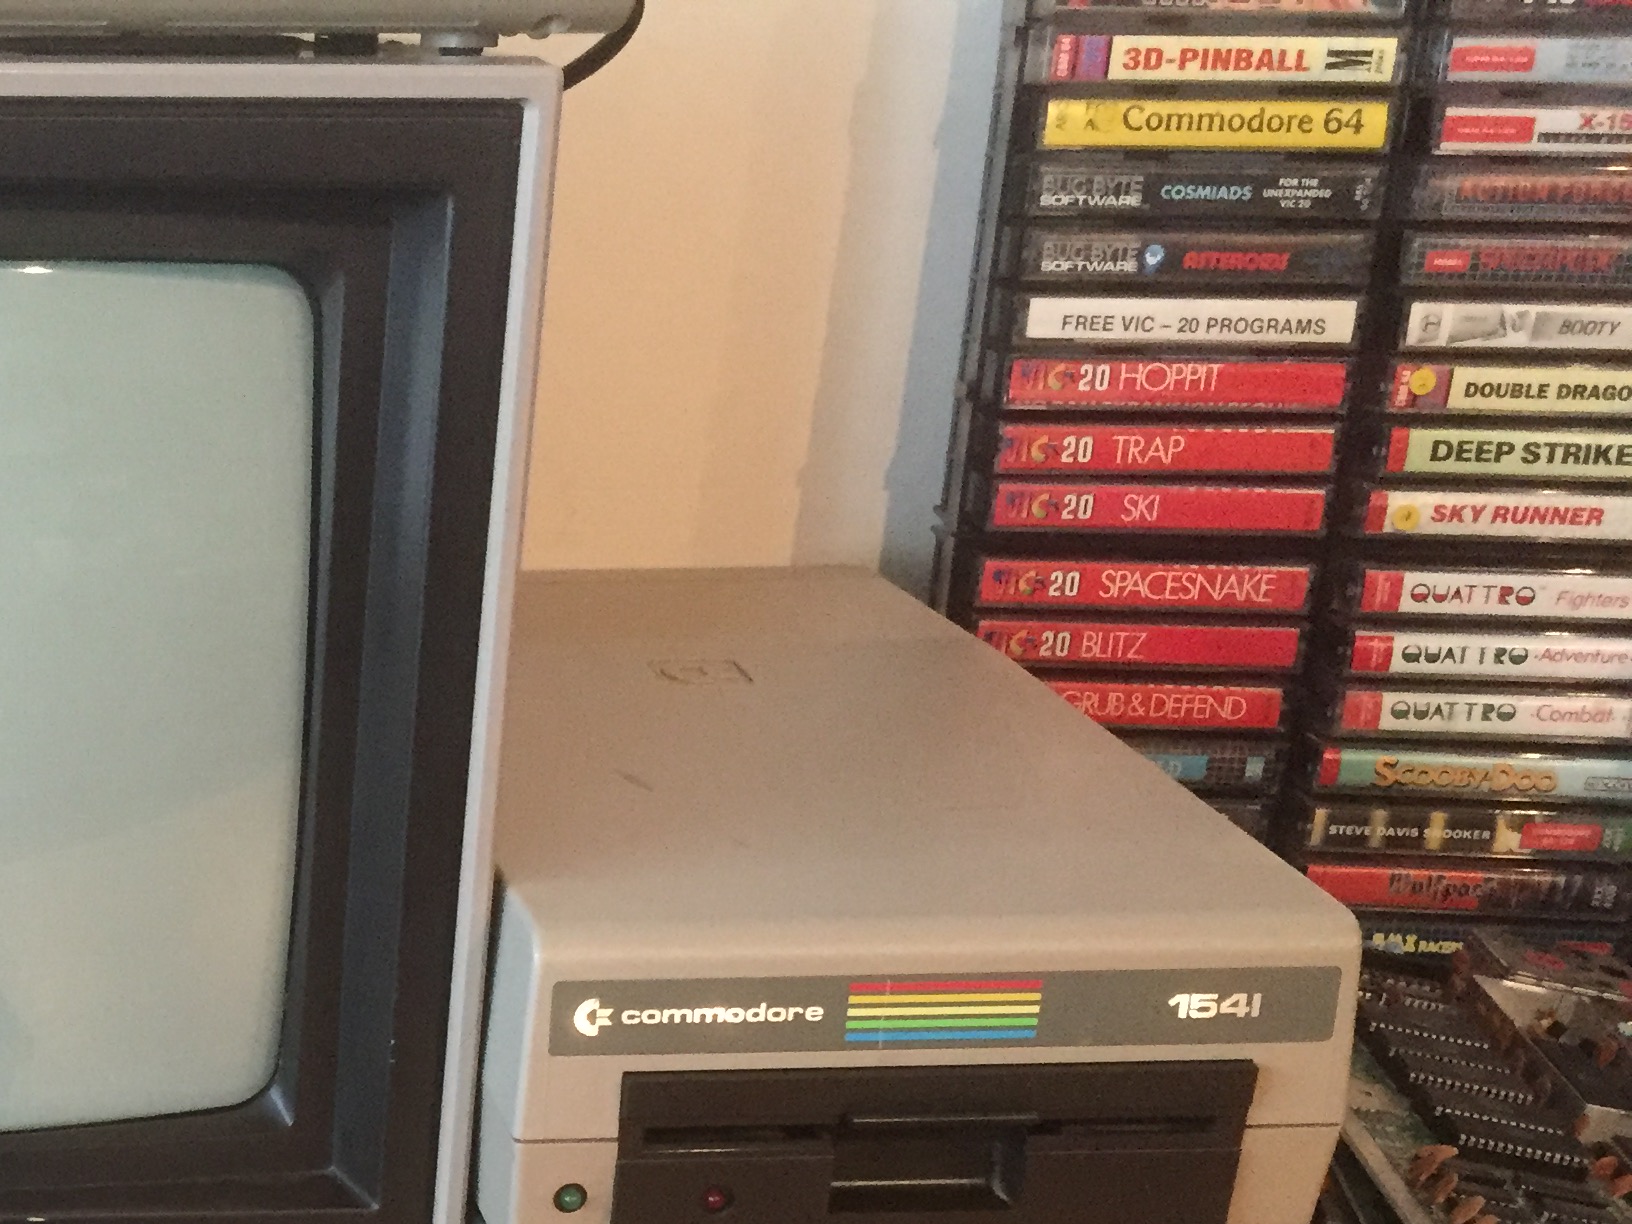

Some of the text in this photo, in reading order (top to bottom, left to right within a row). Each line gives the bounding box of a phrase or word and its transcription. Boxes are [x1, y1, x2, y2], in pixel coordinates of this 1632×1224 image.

[1122, 47, 1310, 73] 3D-PINBALL
[1122, 105, 1313, 134] Commodore
[1323, 107, 1365, 137] 64
[1040, 194, 1143, 208] SOFTWARE
[1160, 184, 1254, 201] COSMIADS
[1041, 260, 1138, 273] SOFTWARE
[1061, 314, 1115, 332] FREE
[1121, 315, 1155, 333] VIC
[1176, 316, 1200, 334] 20
[1206, 317, 1326, 335] PROGRAMS
[1557, 318, 1622, 337] BOOTY
[1118, 362, 1224, 391] HOPPIT
[1464, 381, 1632, 402] DOUBLE DRAGO
[1112, 434, 1185, 465] TRAP
[1429, 439, 1632, 467] DEEP STRIKE
[1120, 493, 1161, 521] SKI
[1430, 503, 1605, 527] SKY RUNNER
[1098, 569, 1278, 603] SPACESNAKE
[1410, 582, 1631, 610] QUATTRO Fighters
[1079, 631, 1148, 660] BLITZ
[1401, 644, 1529, 666] QUATTRO
[1149, 692, 1248, 721] DEFEND
[1390, 700, 1517, 723] QUATTRO
[1328, 824, 1371, 836] STEVE
[1376, 826, 1419, 838] DAVIS
[621, 1002, 825, 1025] commodore
[1168, 992, 1262, 1020] 1541
